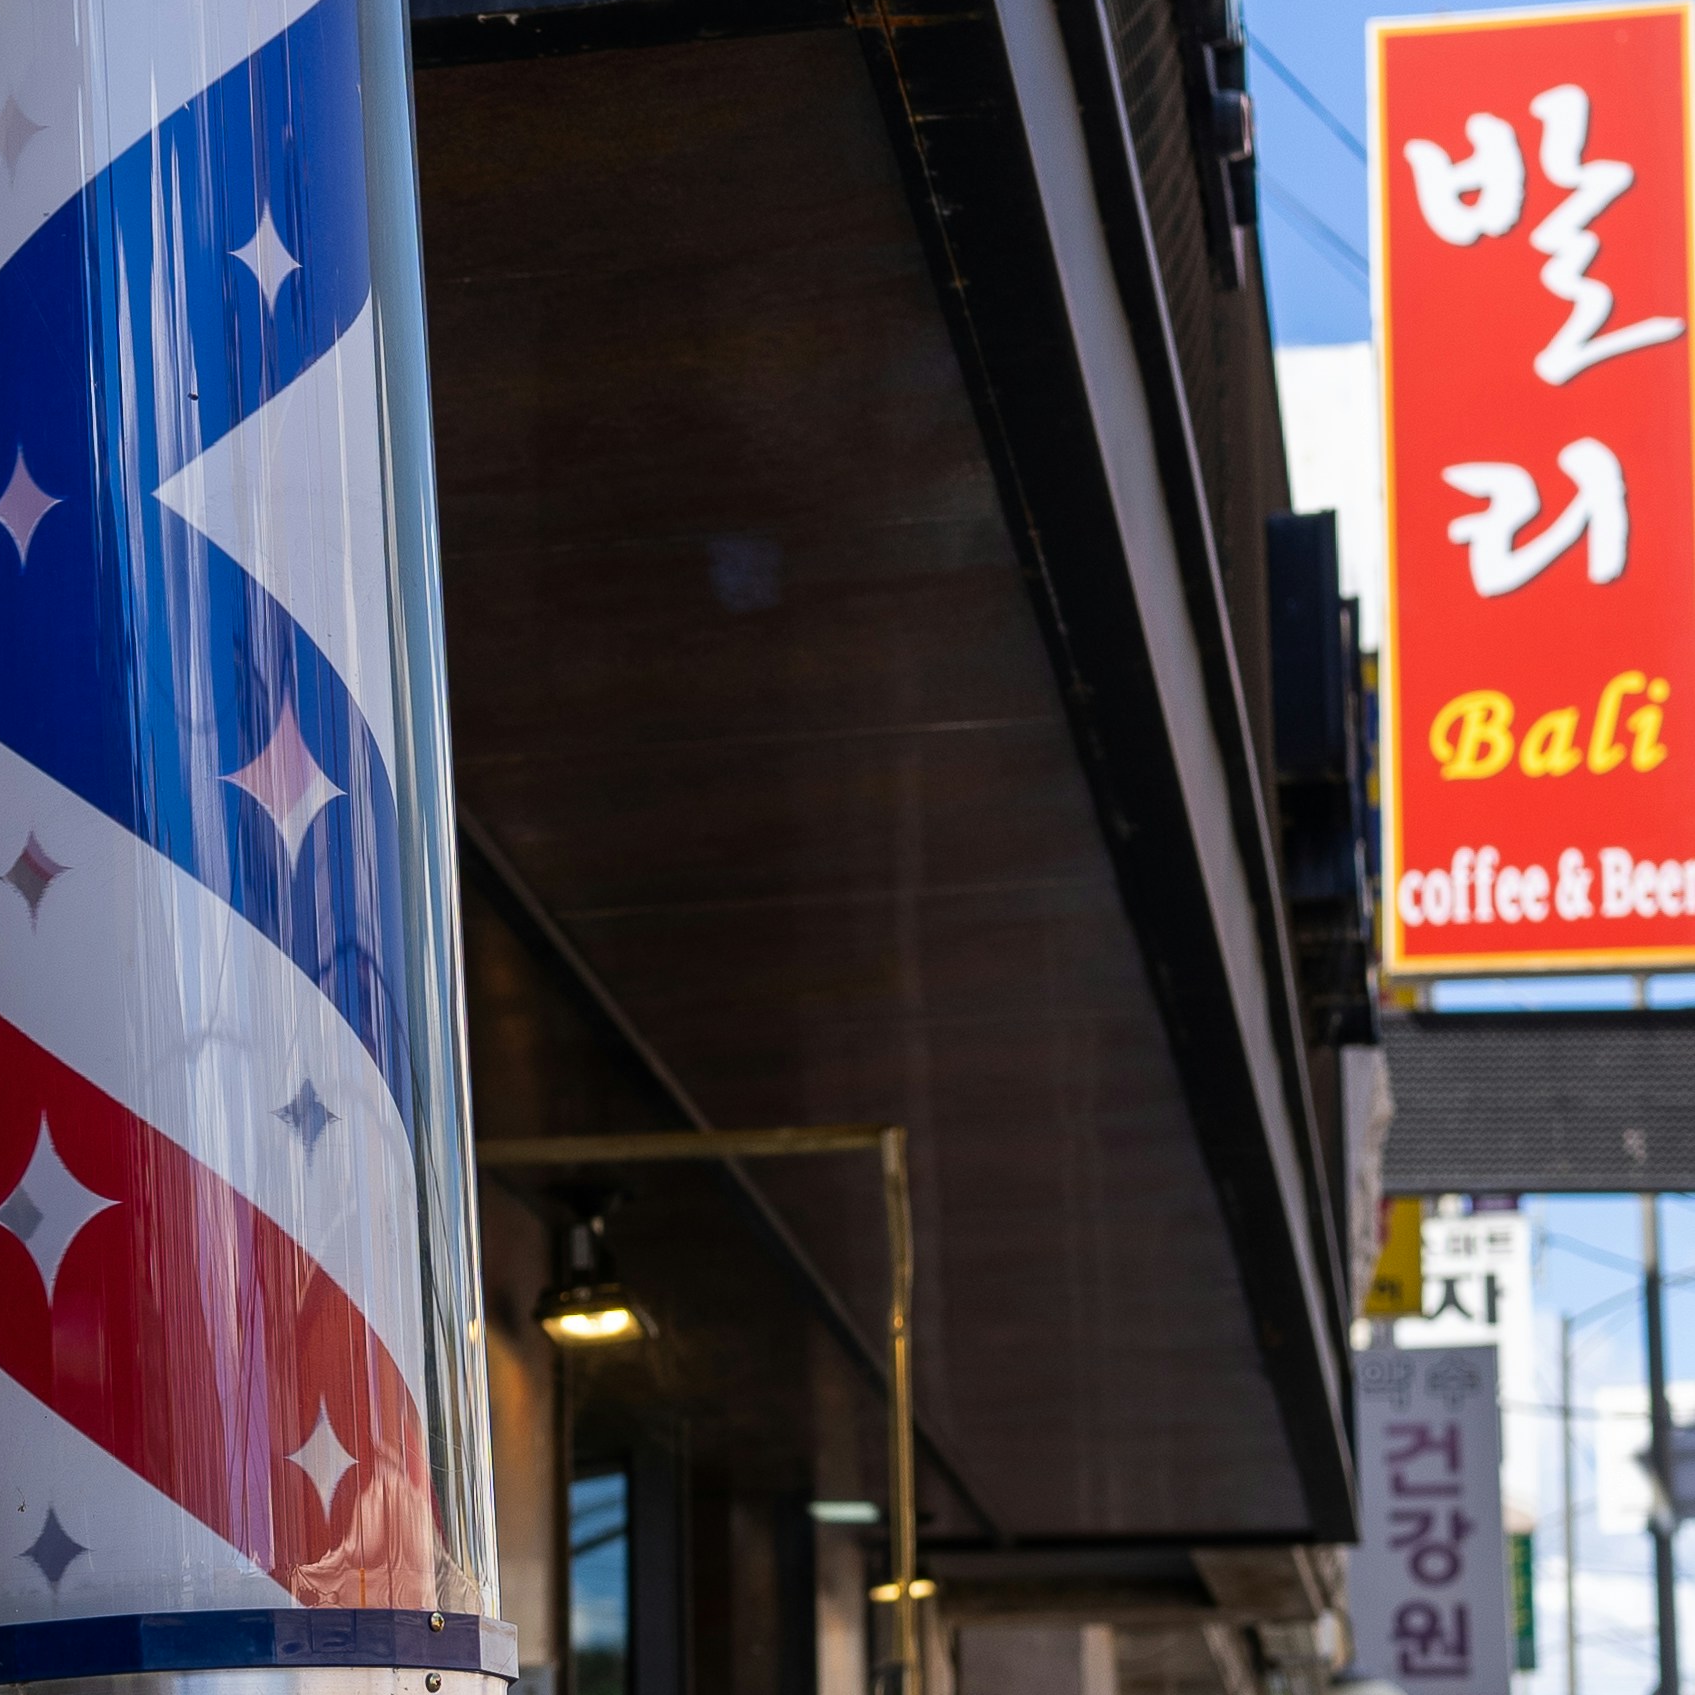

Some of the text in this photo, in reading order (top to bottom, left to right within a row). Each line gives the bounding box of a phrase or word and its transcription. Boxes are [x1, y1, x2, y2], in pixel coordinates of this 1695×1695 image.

[1403, 83, 1685, 598] 발리
[1429, 669, 1671, 781] Bali
[1397, 845, 1551, 927] coffee
[1555, 847, 1594, 921] &
[1383, 1421, 1475, 1680] 건강원
